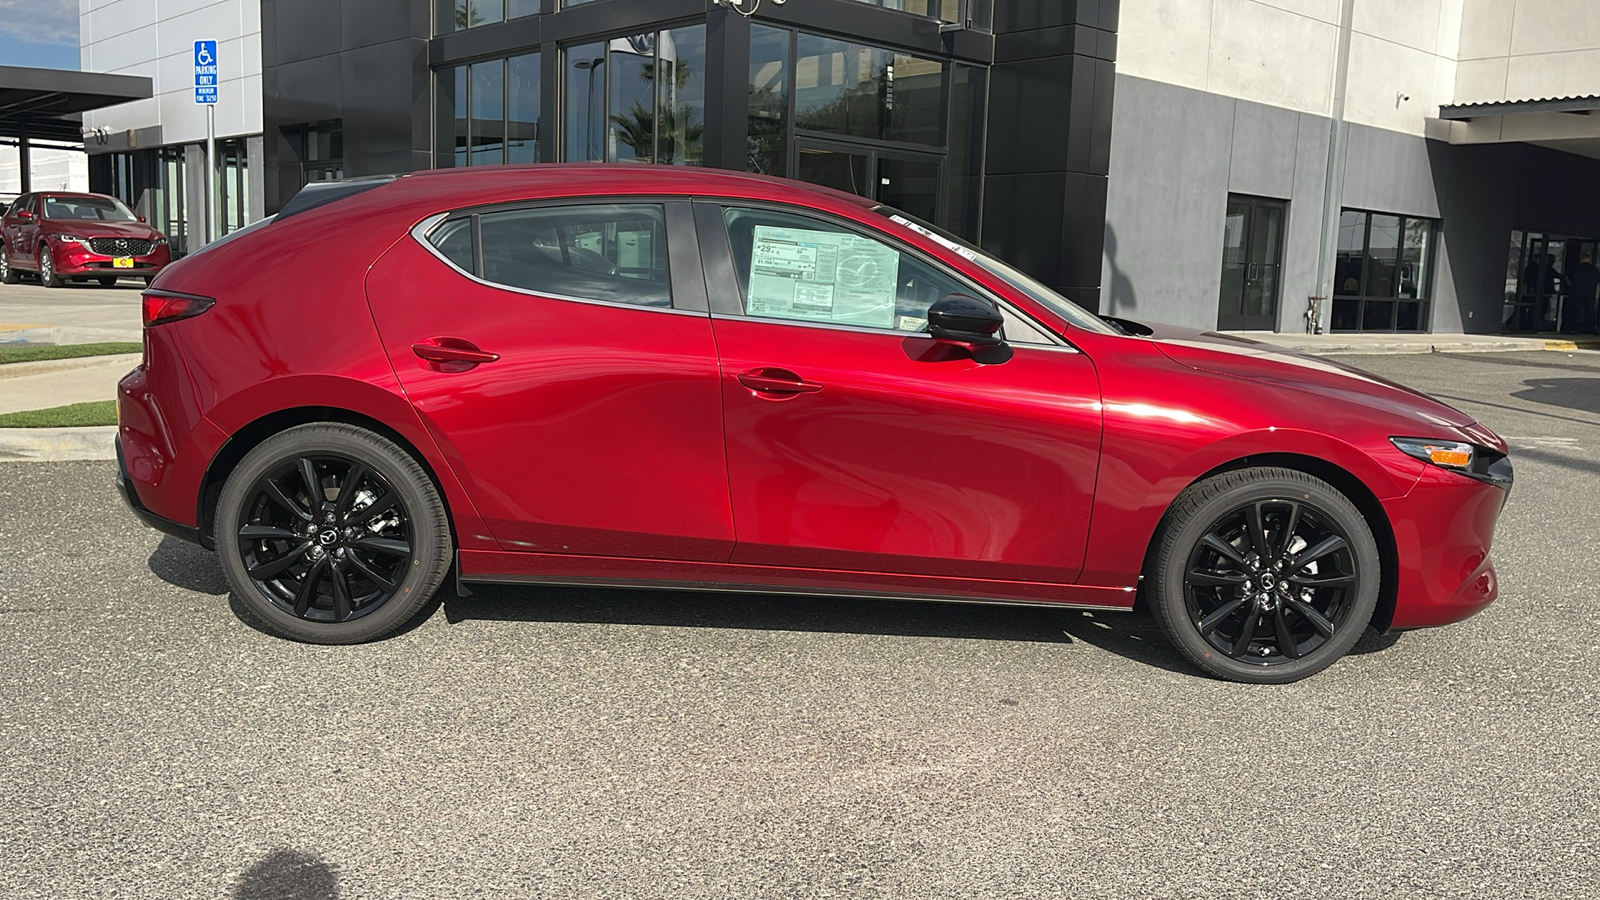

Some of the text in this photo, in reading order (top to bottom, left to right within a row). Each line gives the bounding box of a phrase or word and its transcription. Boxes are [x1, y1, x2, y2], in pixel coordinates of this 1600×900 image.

[195, 65, 217, 75] PARKING
[199, 75, 213, 85] ONLY
[760, 244, 771, 253] 29
